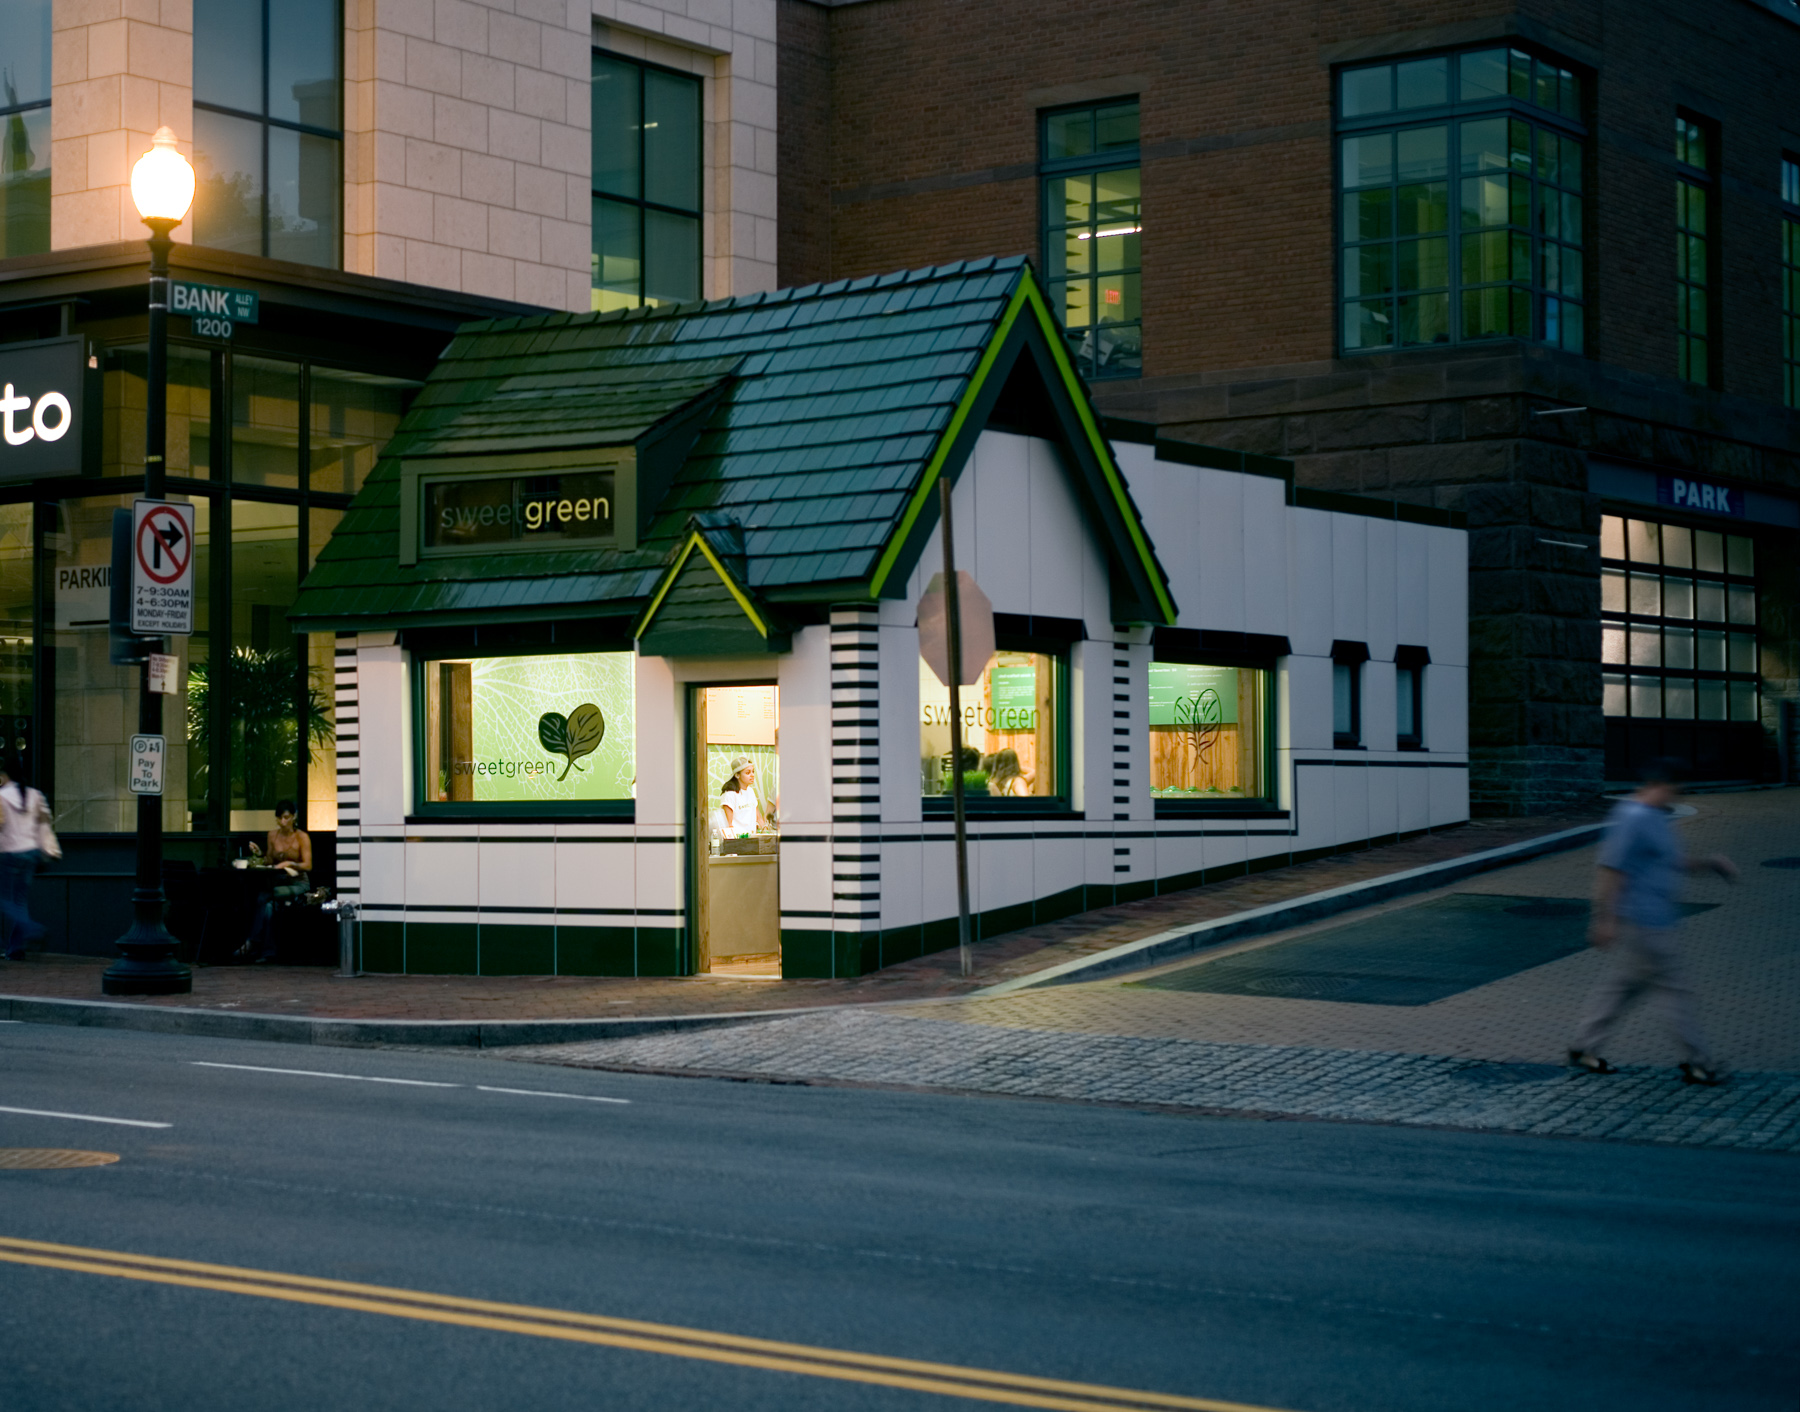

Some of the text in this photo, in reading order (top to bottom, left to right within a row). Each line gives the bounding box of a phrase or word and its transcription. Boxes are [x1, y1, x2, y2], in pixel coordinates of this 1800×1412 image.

[173, 284, 253, 315] BANK ALLEY
[237, 306, 250, 317] NW
[195, 317, 232, 338] 1200
[1673, 477, 1731, 513] PARK
[441, 496, 610, 530] sweetgreen
[60, 566, 111, 590] PARKI
[136, 586, 189, 598] 7-9:30AM
[136, 597, 189, 609] 4-6:30PM
[137, 620, 187, 630] EXCEPT HOLIDAYS
[923, 701, 1041, 733] swetgreen
[138, 758, 155, 769] Pay
[454, 758, 556, 778] sweetgreen
[142, 769, 153, 779] To
[133, 778, 159, 788] Park
